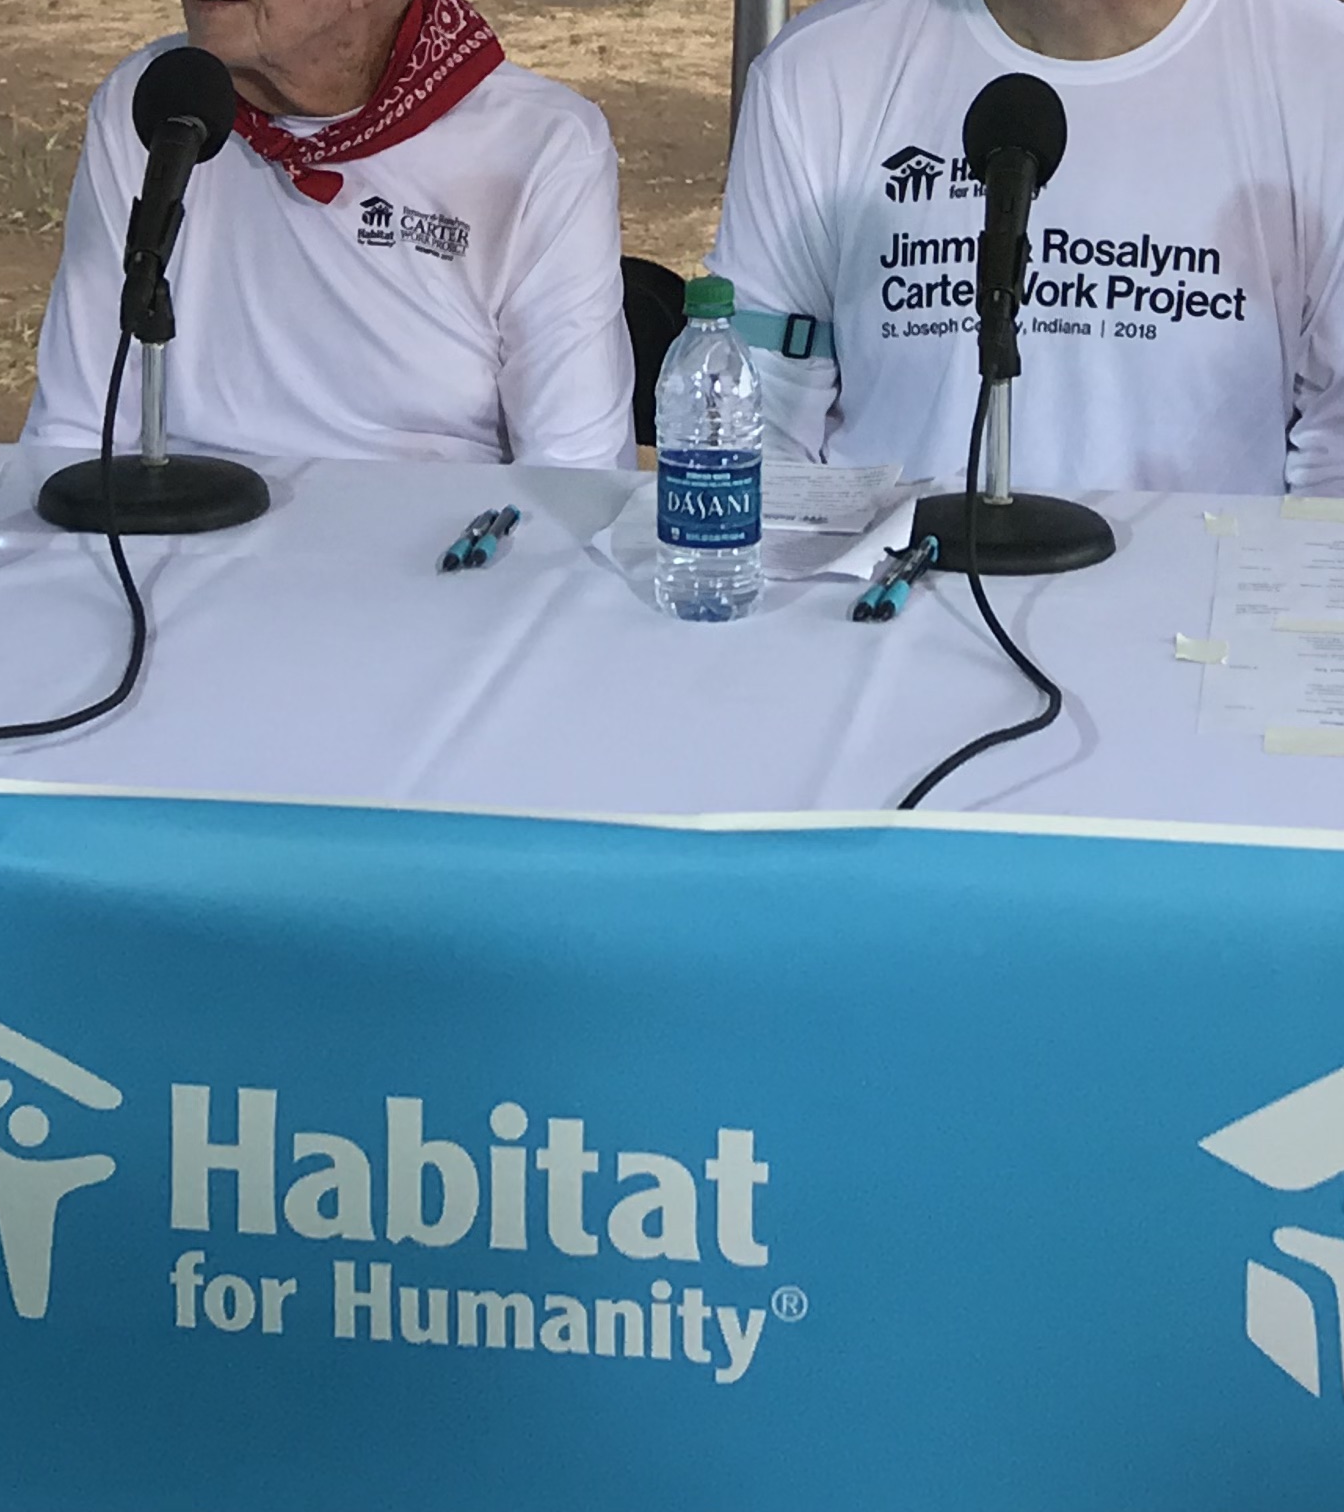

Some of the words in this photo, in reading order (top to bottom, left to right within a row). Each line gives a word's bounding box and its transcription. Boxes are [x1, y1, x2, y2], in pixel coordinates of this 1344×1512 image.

[949, 185, 969, 199] for
[358, 228, 394, 240] Habitat
[400, 215, 469, 248] CARTER
[880, 233, 979, 268] Jimm
[1042, 228, 1220, 277] Rosalynn
[882, 274, 974, 312] Carte
[1106, 275, 1246, 322] Project
[881, 322, 899, 339] St.
[903, 318, 957, 337] Joseph
[1032, 317, 1091, 336] Indiana
[1114, 321, 1157, 340] 2018
[668, 491, 749, 520] DASANI
[171, 1083, 769, 1266] Habitat
[170, 1250, 297, 1334] for
